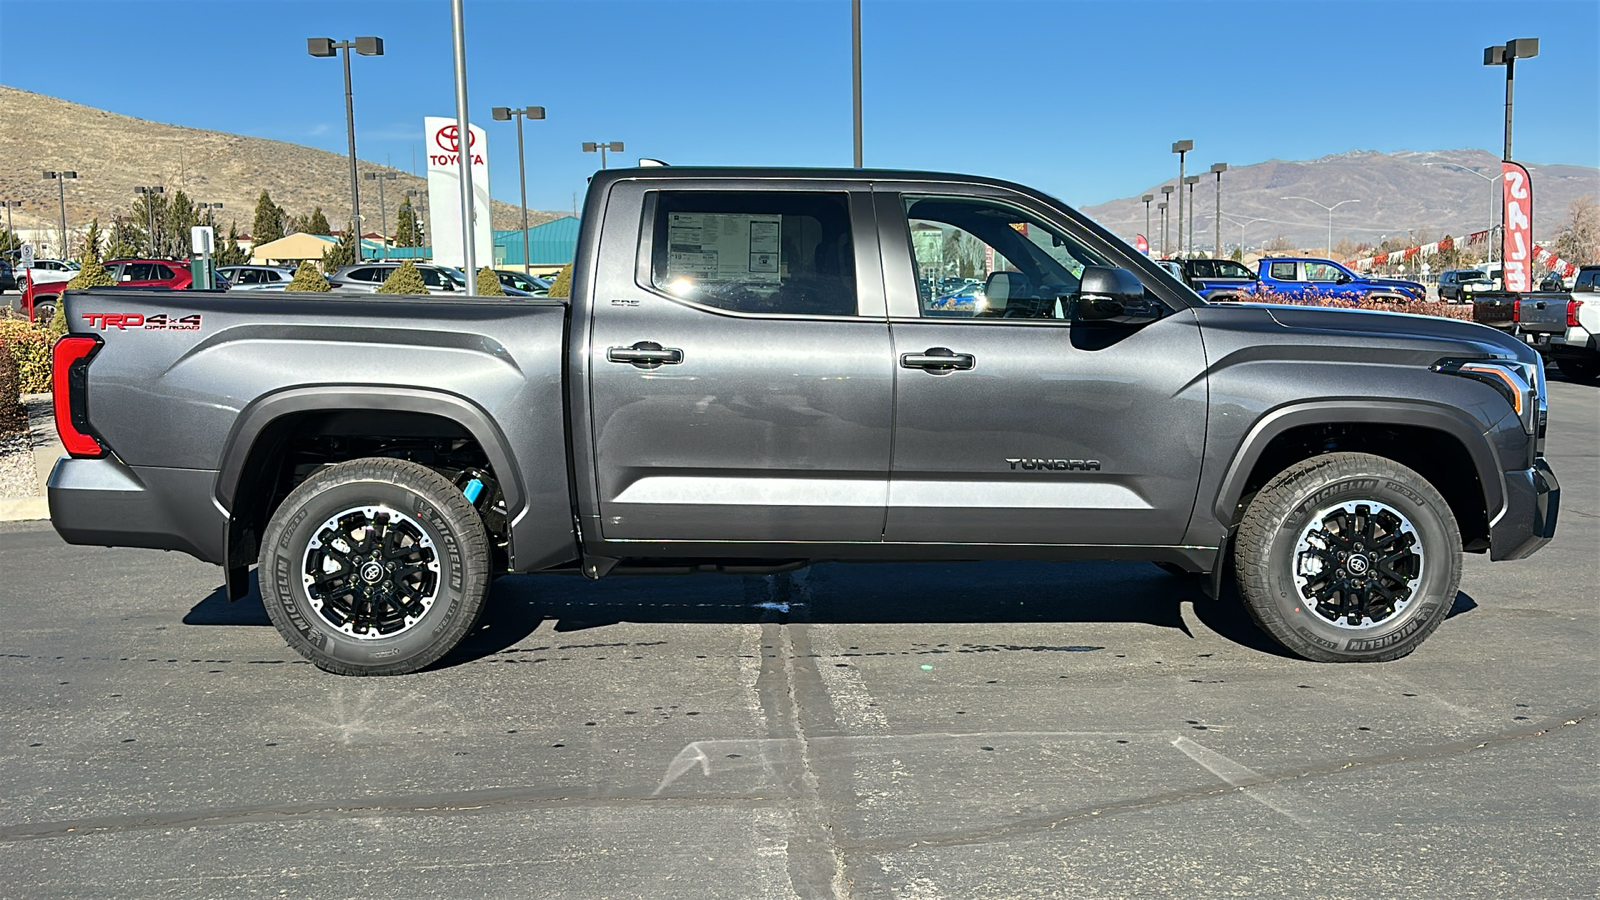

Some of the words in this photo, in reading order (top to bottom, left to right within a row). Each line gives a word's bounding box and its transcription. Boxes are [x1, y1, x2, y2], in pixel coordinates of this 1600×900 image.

[430, 155, 484, 166] TOYA
[82, 313, 144, 330] TRD
[1006, 458, 1101, 471] TUNDRA
[1306, 480, 1374, 512] MICHELIN
[432, 518, 461, 588] MICHELIN
[278, 560, 308, 630] MICHELIN
[1350, 620, 1416, 650] MICHELIN
